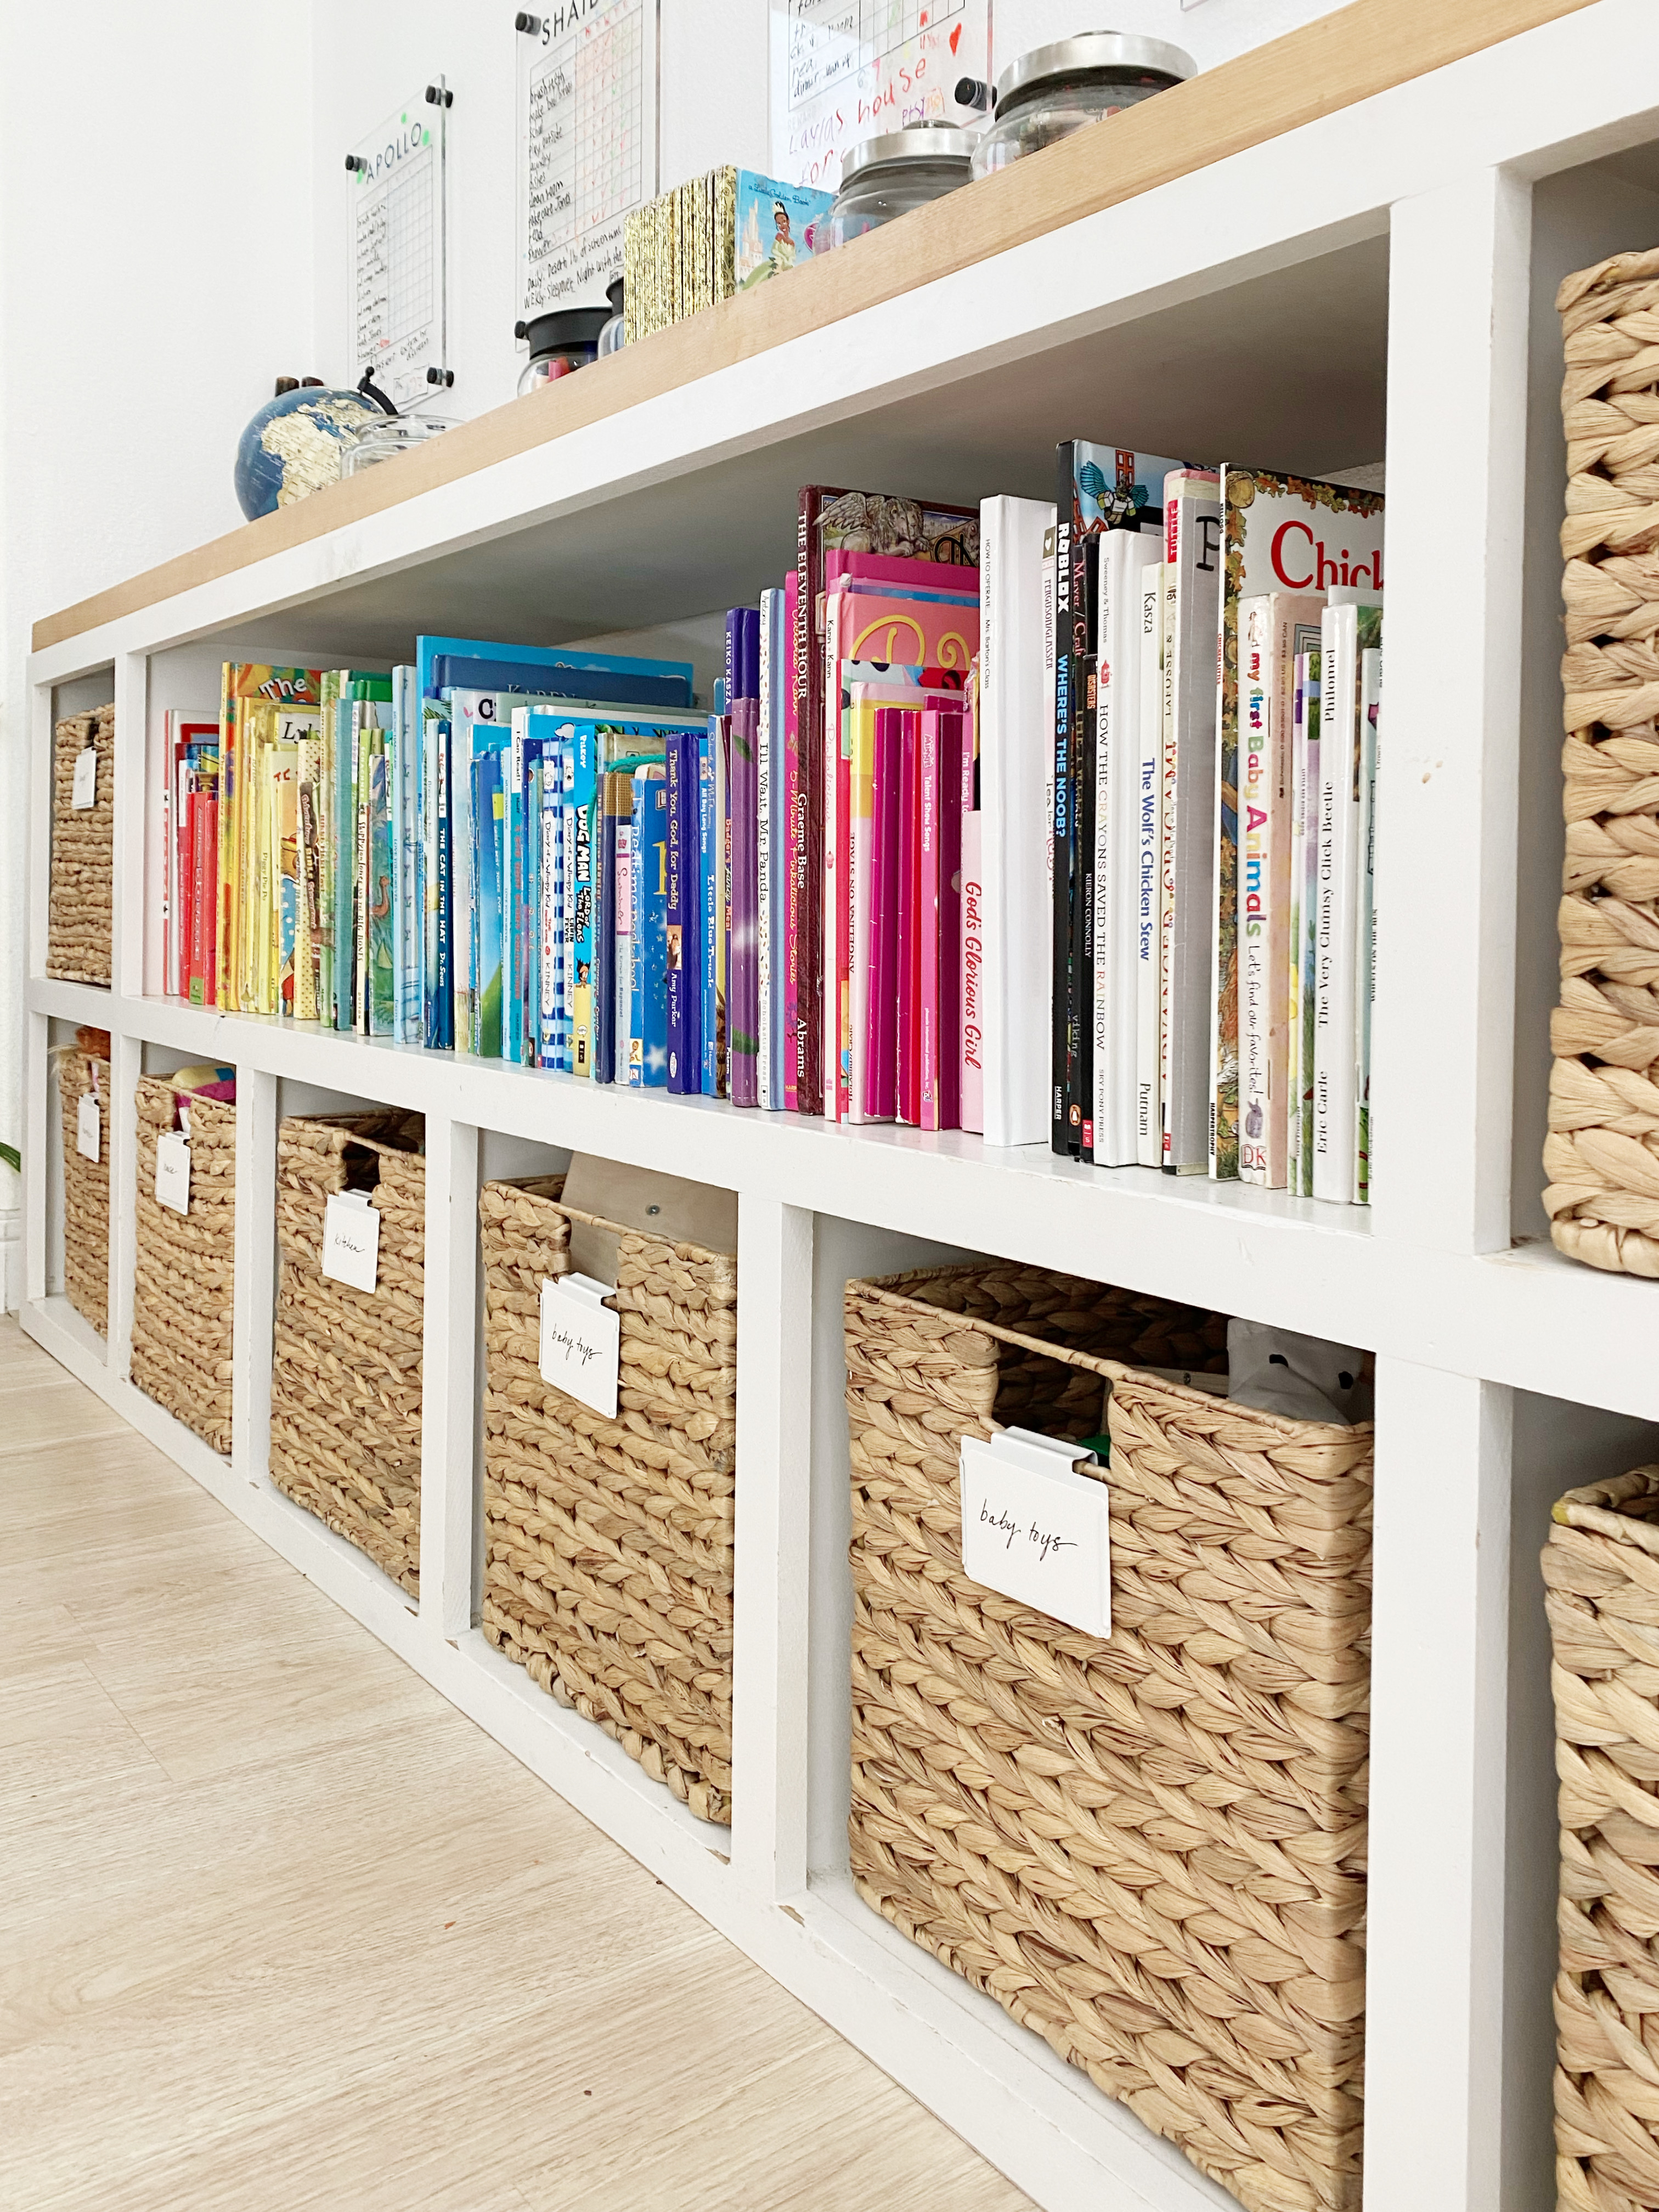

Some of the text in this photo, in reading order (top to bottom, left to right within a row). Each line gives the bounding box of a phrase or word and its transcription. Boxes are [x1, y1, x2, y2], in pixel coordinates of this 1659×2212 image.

[366, 122, 422, 184] APOLLO
[985, 561, 991, 572] TO
[1057, 522, 1070, 614] ROBLOX
[798, 510, 807, 700] THE ELEVENTH HOUR
[1144, 591, 1156, 634] Kasza
[260, 675, 307, 702] The
[1086, 674, 1096, 710] DISASTERS
[1323, 649, 1337, 723] Philomel
[825, 723, 836, 824] Pinkalicious
[1056, 654, 1068, 838] WHERE'S THE NOOB?
[924, 775, 932, 801] Talent
[961, 752, 970, 803] I'm Ready
[1244, 652, 1268, 938] my first Baby Animals
[577, 804, 591, 882] DOG MAN
[668, 749, 679, 910] Thank You, God, for Daddy
[760, 744, 769, 904] I'll Wait, Mr. Panda
[797, 793, 807, 889] Graeme Base
[923, 827, 932, 853] Songs
[305, 848, 313, 879] BIBLE
[439, 880, 446, 892] IN
[849, 879, 855, 900] ON
[1096, 704, 1108, 1051] HOW THE CRAYONS SAVED THE RAINBOW
[1140, 757, 1155, 962] The Wolf's Chicken Stew
[618, 868, 630, 925] Summer
[790, 846, 799, 986] Pinkalicious Stories
[1318, 781, 1334, 1029] The Very Clumsy Click Beetle
[707, 874, 715, 989] Little Blue Truck
[669, 973, 678, 992] Amy
[964, 881, 982, 1070] God's Glorious Girl
[797, 1017, 806, 1079] Abrams
[1071, 1014, 1080, 1058] viking
[1246, 945, 1265, 1094] Let's find our favorites!
[1139, 1082, 1152, 1137] Putnam
[1317, 1070, 1330, 1154] Eric Carle
[1243, 1145, 1267, 1167] DK
[335, 1231, 365, 1253] kitchen
[551, 1323, 603, 1367] baby toys
[980, 1498, 1079, 1561] baby toys
